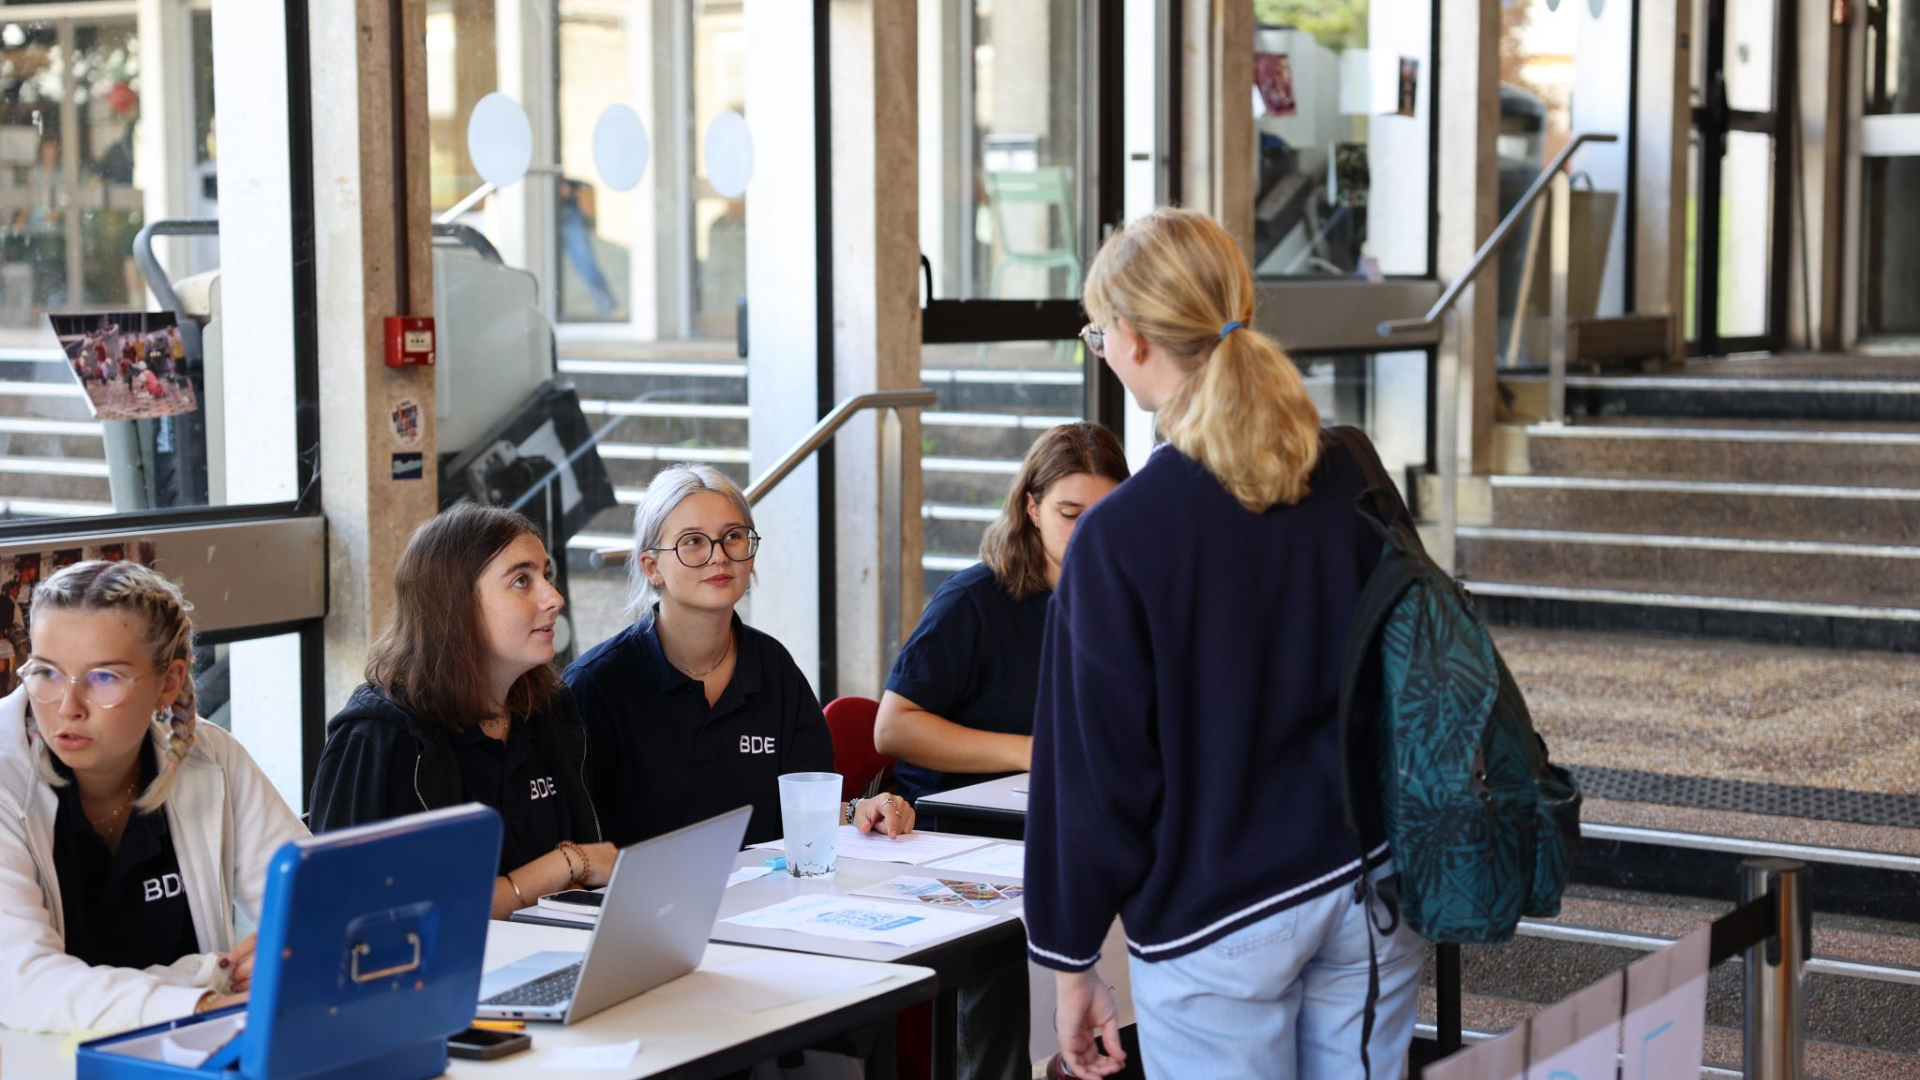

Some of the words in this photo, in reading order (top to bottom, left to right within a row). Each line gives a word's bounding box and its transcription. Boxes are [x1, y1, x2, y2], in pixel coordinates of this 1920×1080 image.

[739, 734, 775, 754] BDE
[530, 776, 557, 801] BDE
[143, 872, 185, 902] BD
